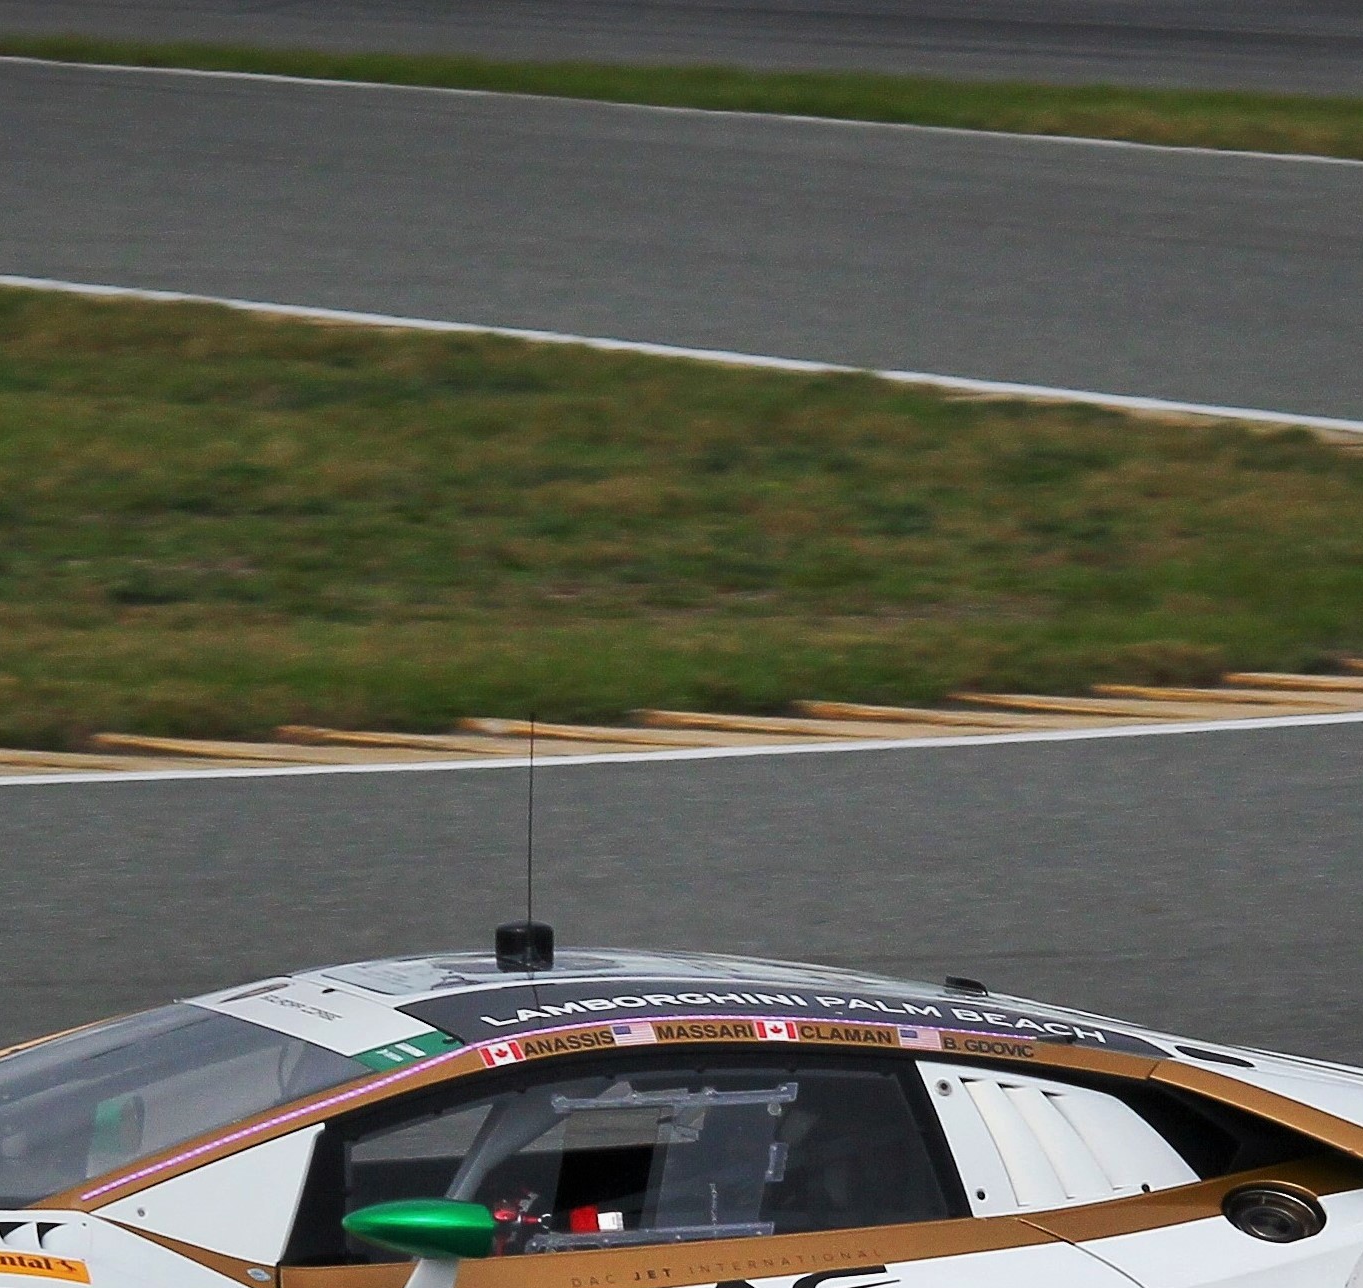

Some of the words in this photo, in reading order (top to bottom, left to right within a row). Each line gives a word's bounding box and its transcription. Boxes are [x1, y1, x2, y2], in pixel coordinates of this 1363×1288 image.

[480, 992, 810, 1027] LAMBORGHINI
[816, 995, 943, 1018] PALM
[951, 1008, 1108, 1044] BEACH
[523, 1031, 614, 1057] ANASSIS
[656, 1024, 755, 1040] MASSARI
[800, 1025, 892, 1045] CLAMAN
[944, 1037, 961, 1050] B.
[964, 1040, 1035, 1058] GDOVIC
[571, 1274, 614, 1288] DAC
[634, 1267, 672, 1282] JET
[689, 1249, 883, 1275] INTERNATIONAL
